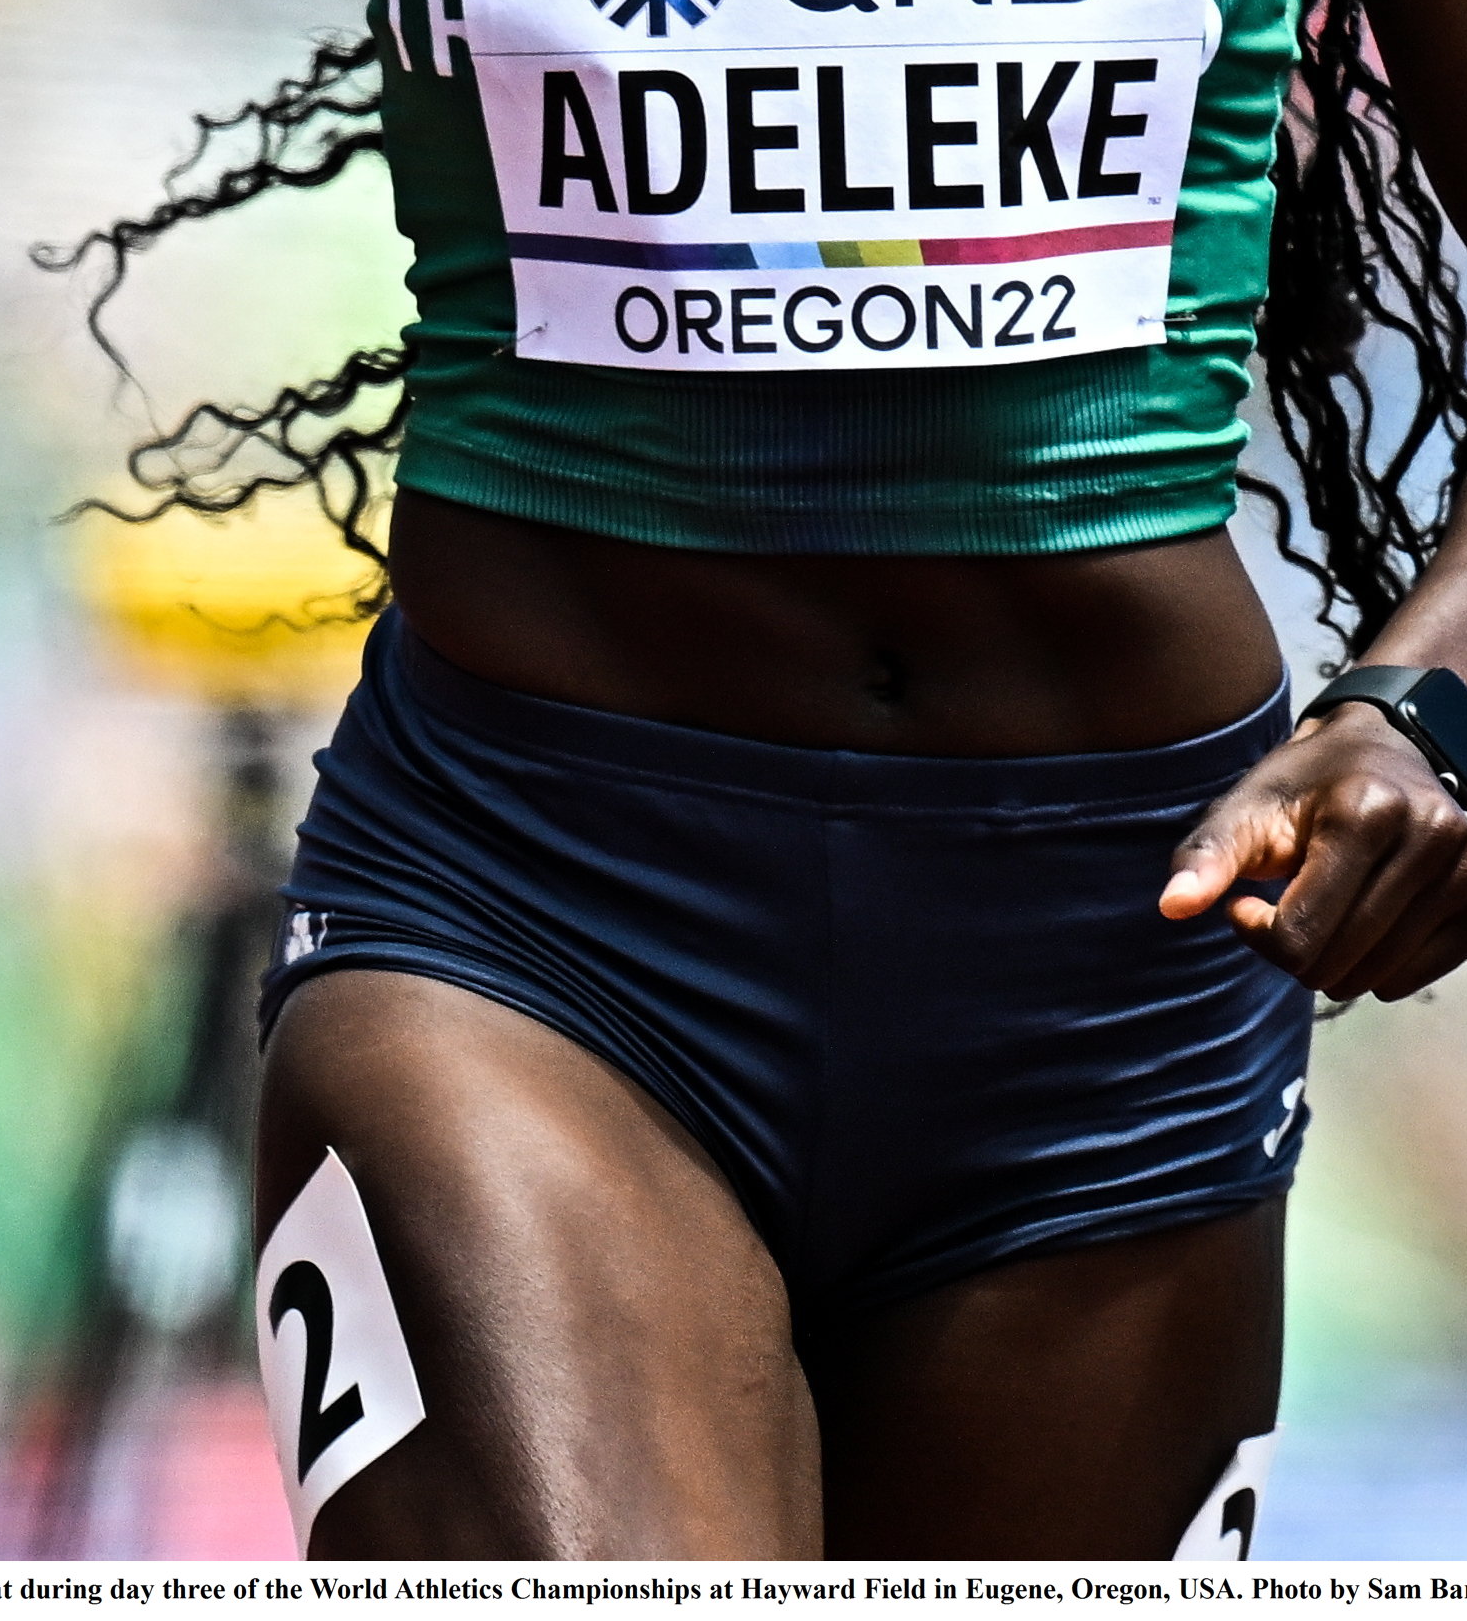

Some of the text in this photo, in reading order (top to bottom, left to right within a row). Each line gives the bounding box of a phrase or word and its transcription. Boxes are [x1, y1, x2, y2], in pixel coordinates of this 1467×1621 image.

[539, 59, 1158, 215] ADELEKE
[615, 275, 1076, 353] OREGON22
[269, 1260, 366, 1488] 2
